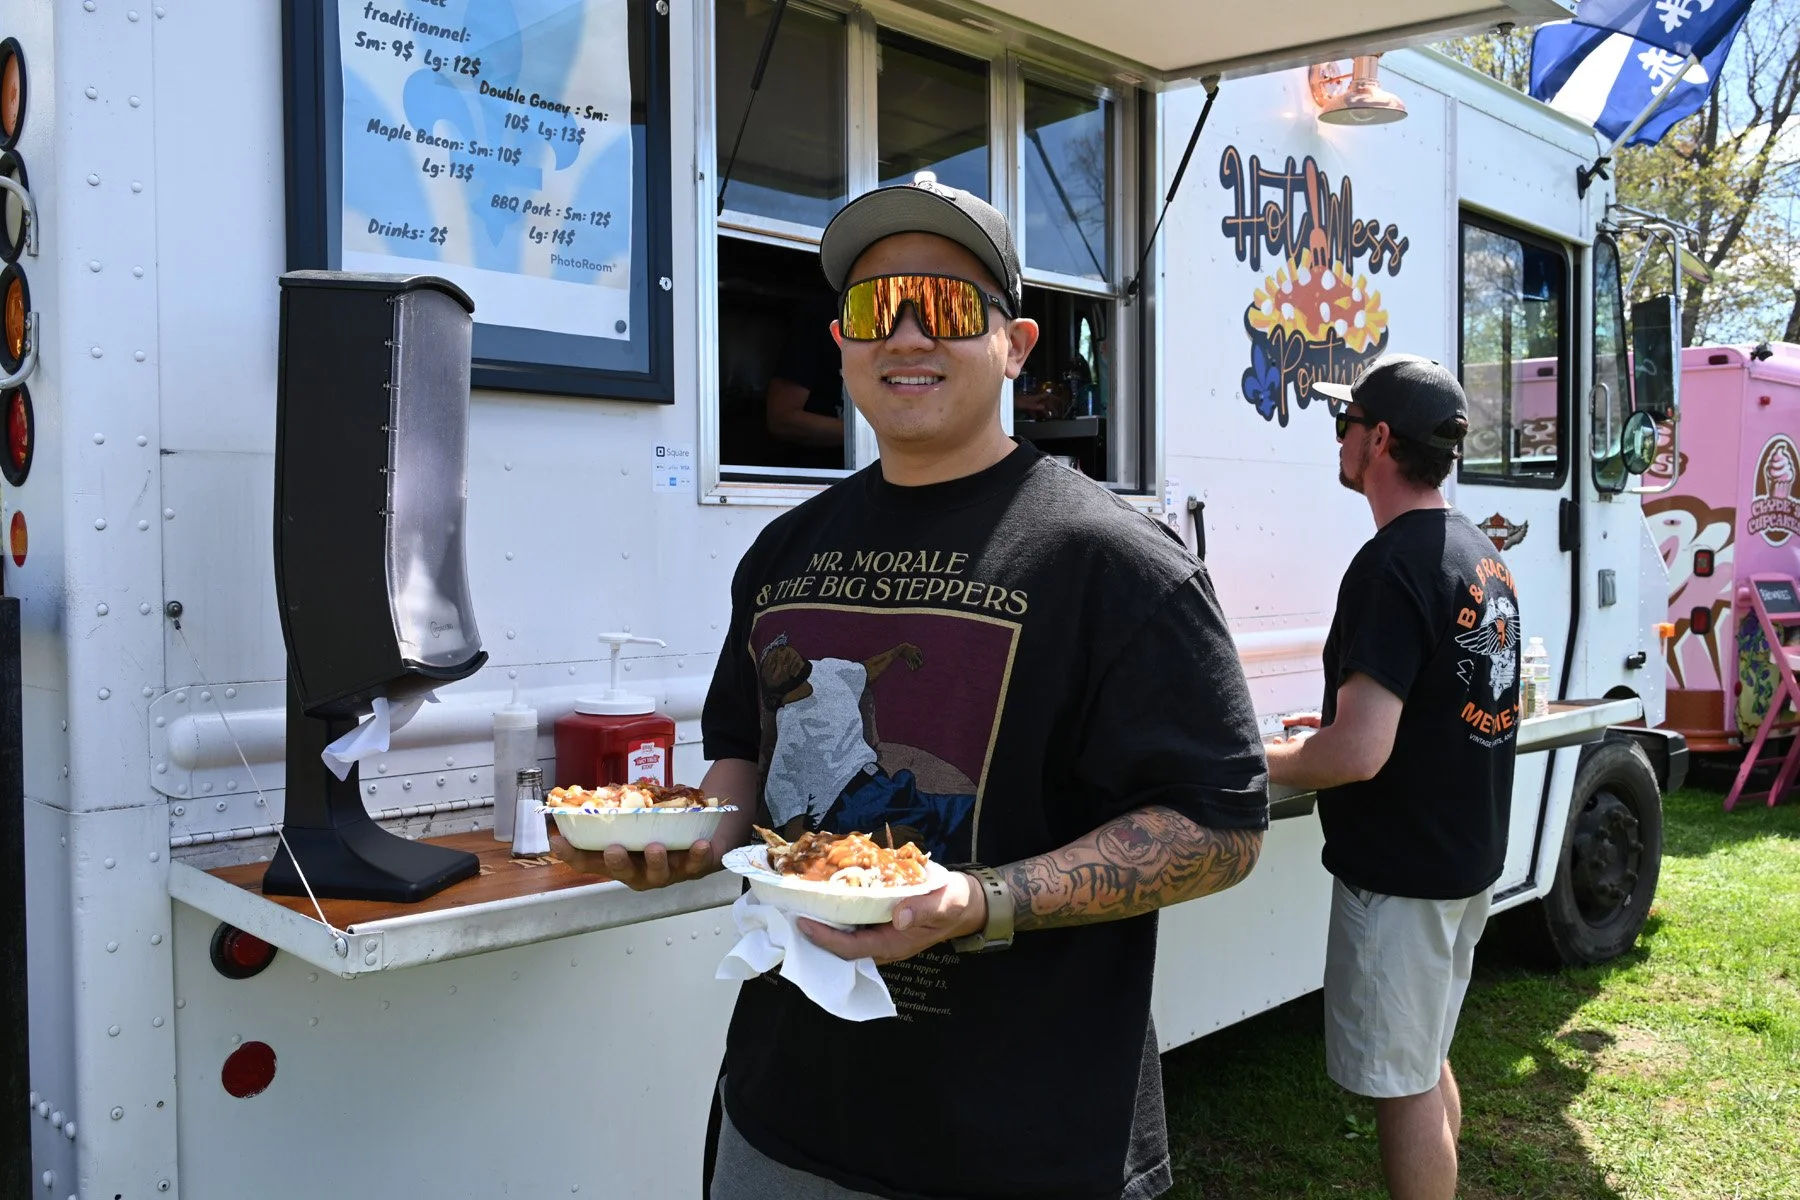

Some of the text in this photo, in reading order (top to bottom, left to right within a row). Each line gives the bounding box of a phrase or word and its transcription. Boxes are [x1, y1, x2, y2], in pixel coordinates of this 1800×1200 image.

[364, 1, 471, 43] traditionnel:
[355, 31, 481, 77] Sm: 9$ Lg: 12$
[480, 80, 525, 105] Double
[530, 94, 571, 119] Gooey
[584, 105, 608, 121] Sm:
[366, 118, 522, 166] Maple Bacon: Sm: 10$
[504, 113, 586, 145] 10$ Lg: 13$
[422, 157, 474, 182] Lg: 13$
[491, 194, 519, 213] BBQ
[522, 199, 552, 217] Pork
[564, 207, 587, 222] Sm:
[590, 211, 611, 228] 12$
[1220, 145, 1410, 277] Hot Mess
[368, 218, 448, 246] Drinks: 2$
[529, 226, 575, 247] Lg: 14$
[1268, 324, 1368, 428] Poutin
[667, 448, 690, 458] Square
[806, 550, 969, 575] MR. MORALE
[756, 575, 1029, 616] & THE BIG STEPPERS
[1456, 607, 1477, 629] B
[1469, 584, 1484, 604] &
[1481, 557, 1518, 599] RACIN
[1469, 733, 1492, 750] VINTAGE
[912, 964, 940, 975] rapper
[926, 951, 940, 962] the
[941, 954, 960, 965] fifth
[887, 983, 927, 1000] Top Dawg
[901, 975, 913, 983] on
[916, 977, 933, 989] May
